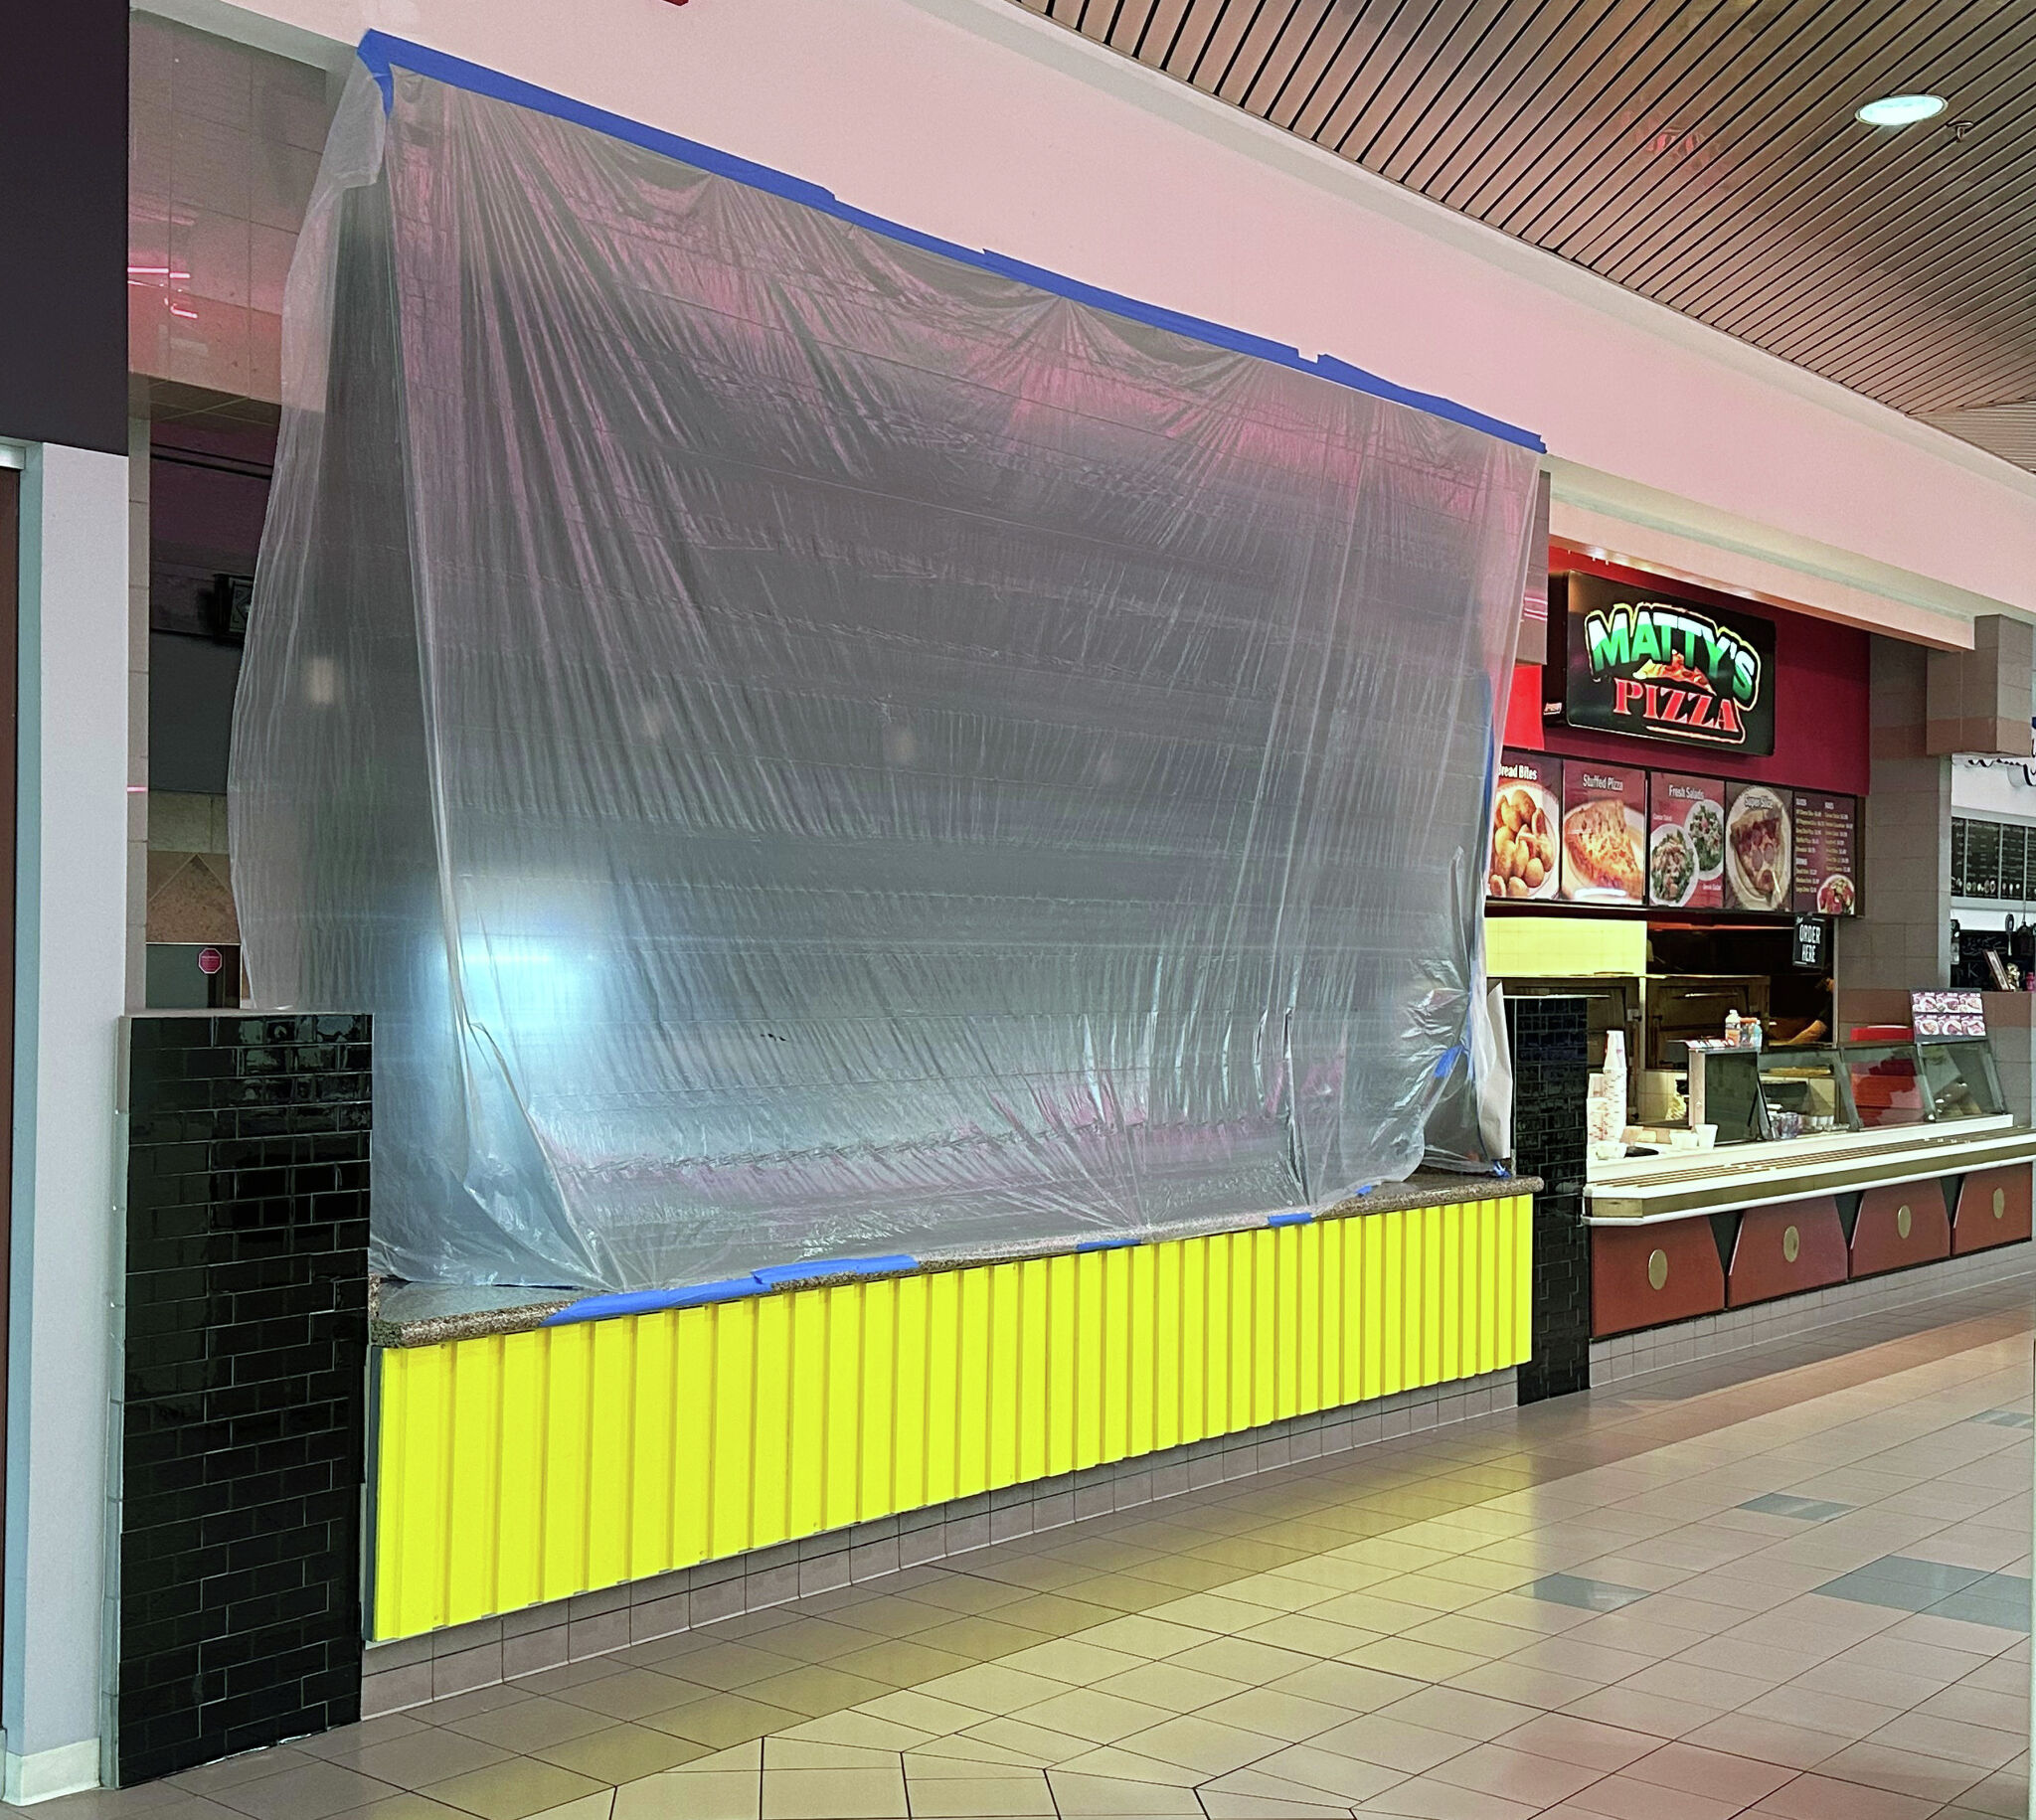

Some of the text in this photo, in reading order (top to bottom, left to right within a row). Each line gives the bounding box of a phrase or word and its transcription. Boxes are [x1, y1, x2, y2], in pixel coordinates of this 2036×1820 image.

[1588, 610, 1756, 701] MATTY'S
[1612, 677, 1739, 733] PIZZA
[1519, 764, 1538, 781] Bites
[1583, 773, 1623, 791] Stuffed Pizza
[1669, 784, 1704, 801] Fresh Salads
[1799, 923, 1821, 944] ORDER
[1801, 944, 1816, 963] HERE
